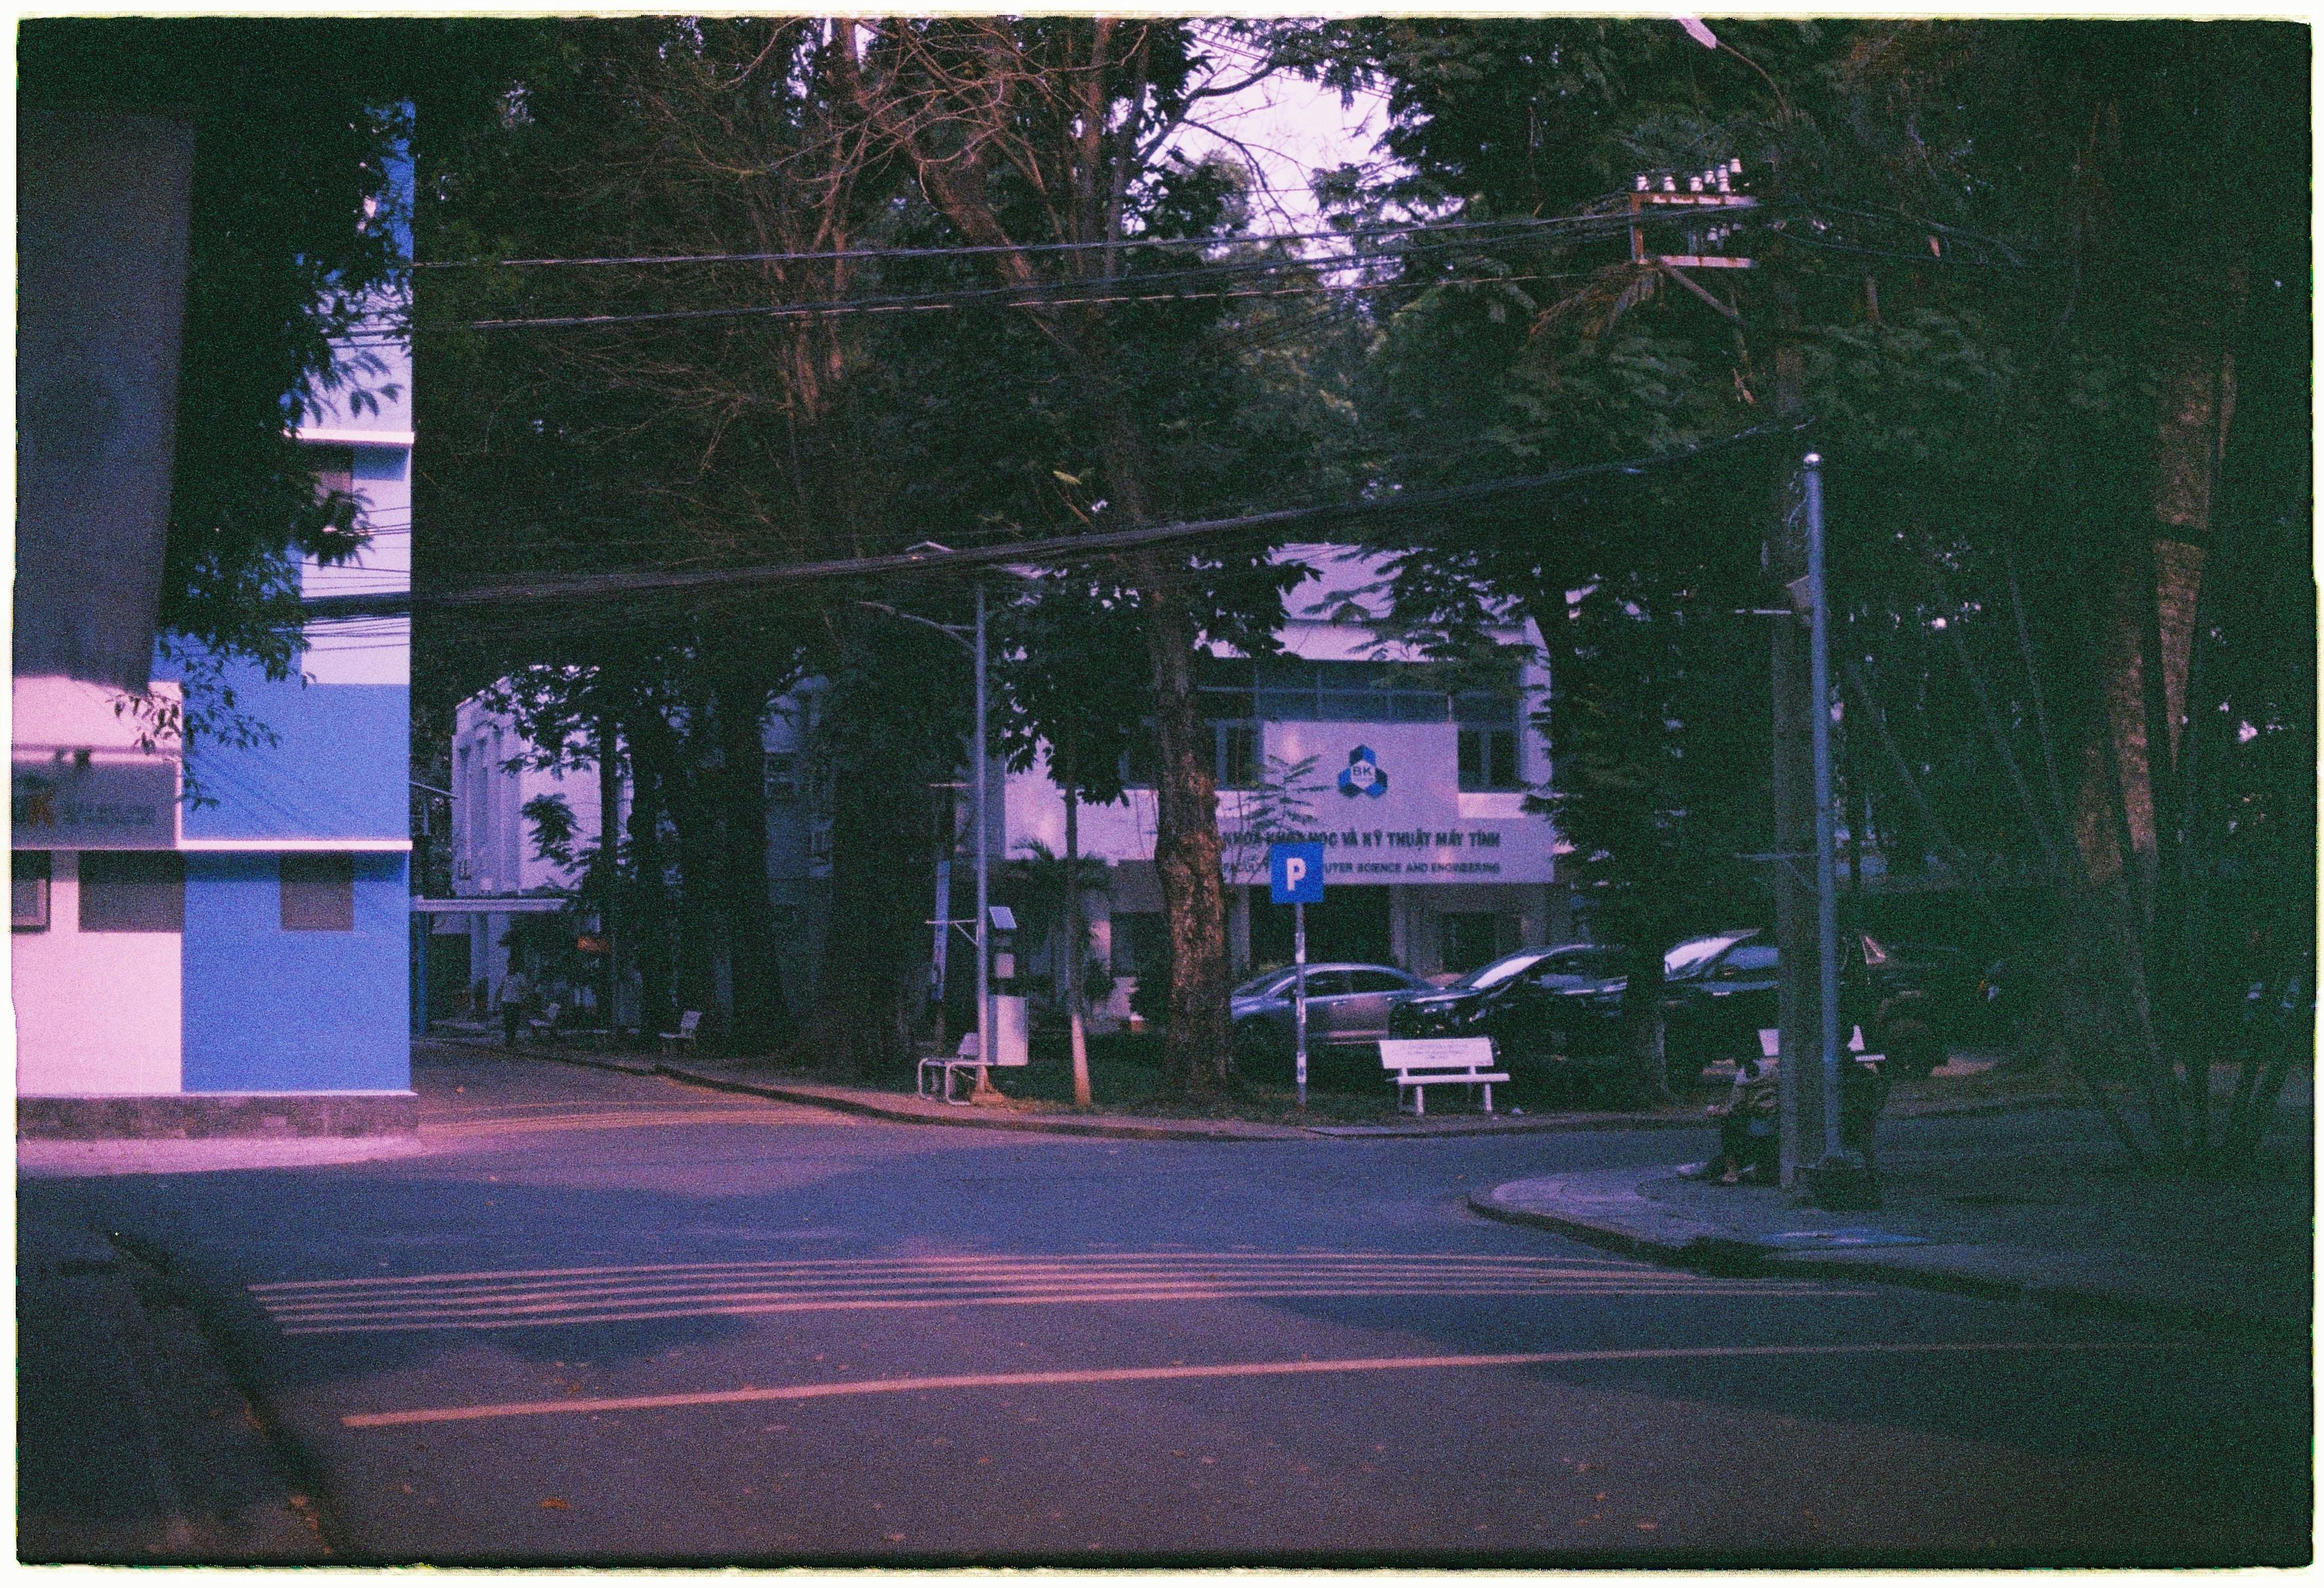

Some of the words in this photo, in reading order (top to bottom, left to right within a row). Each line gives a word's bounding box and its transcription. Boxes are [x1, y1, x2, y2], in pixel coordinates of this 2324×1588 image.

[1353, 766, 1372, 776] BK
[1406, 863, 1428, 872] AND
[1286, 857, 1306, 892] P
